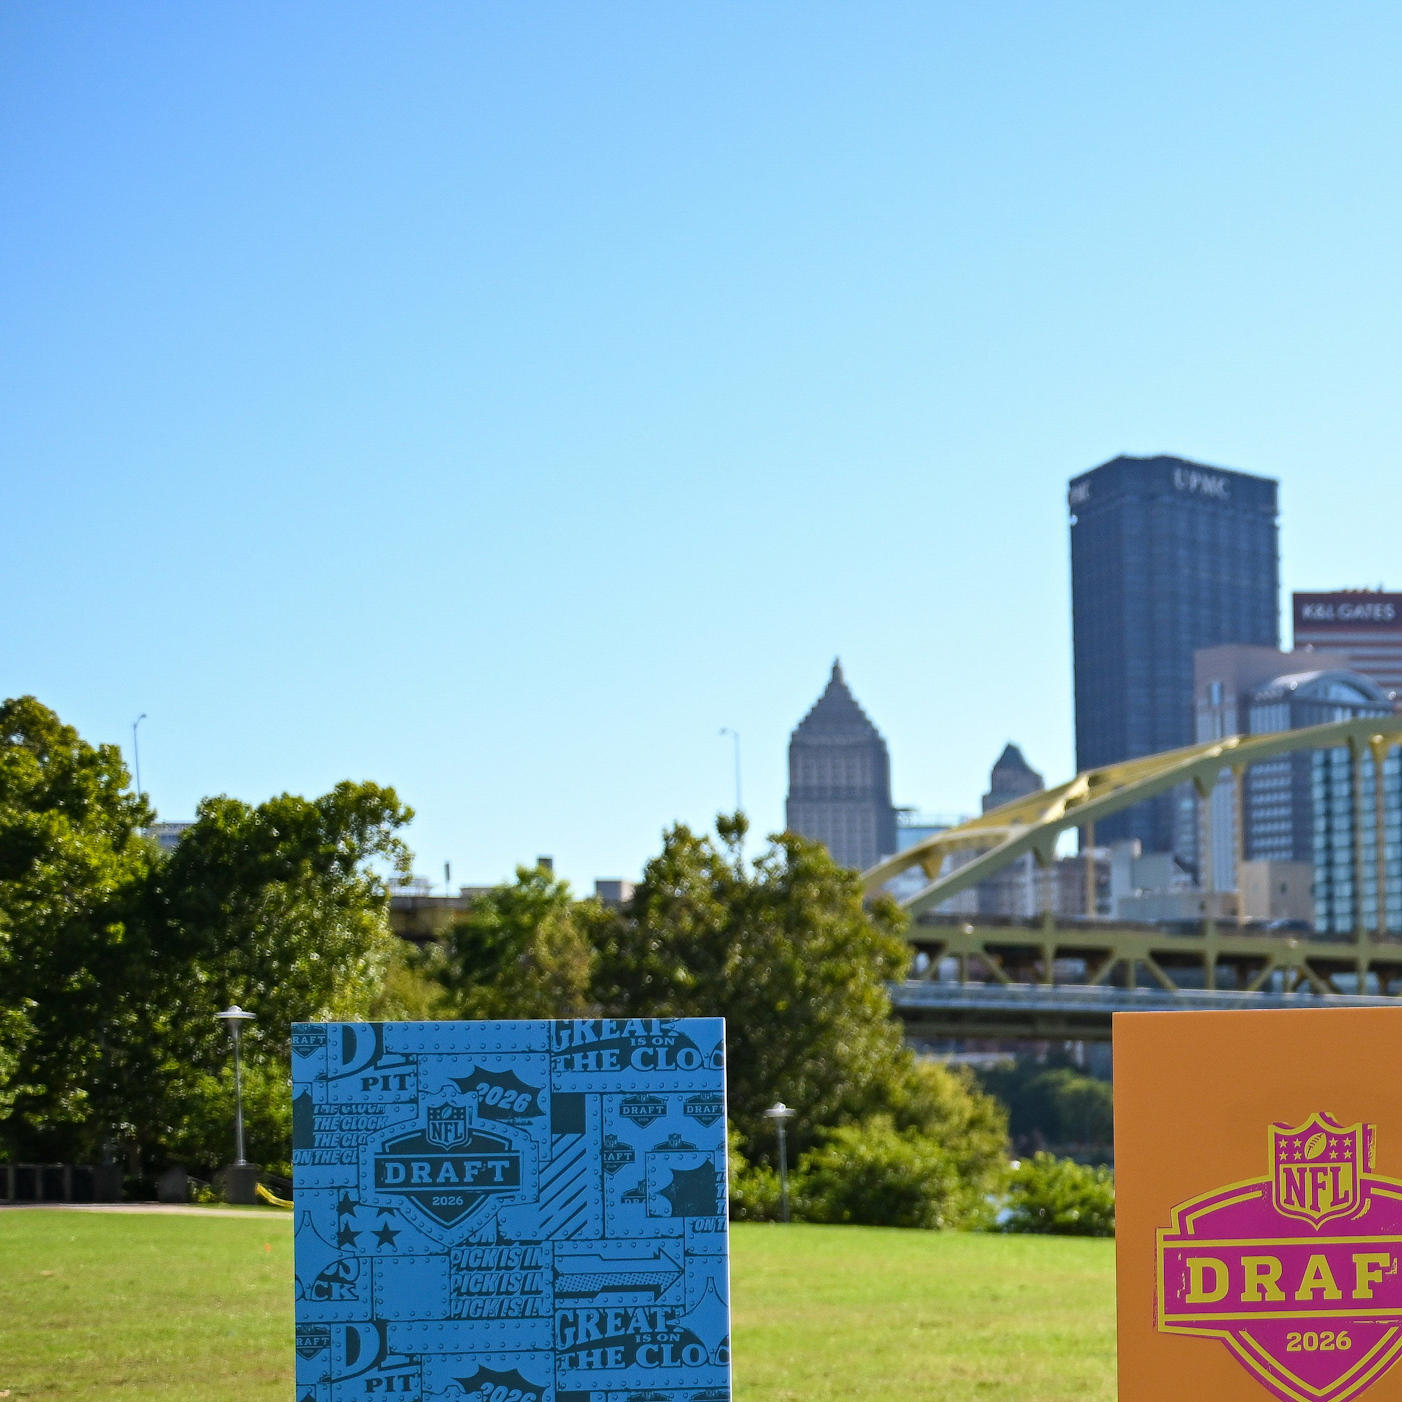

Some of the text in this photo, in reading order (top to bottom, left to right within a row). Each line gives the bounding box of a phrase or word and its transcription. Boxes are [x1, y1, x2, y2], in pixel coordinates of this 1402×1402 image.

[1337, 602, 1396, 620] GATES
[631, 1036, 675, 1047] IS ON
[552, 1049, 621, 1072] THE
[476, 1082, 533, 1113] 2026
[622, 1105, 664, 1115] DRAFT
[314, 1116, 339, 1132] THE
[431, 1121, 464, 1143] NFL
[314, 1132, 339, 1149] THE
[312, 1149, 339, 1165] THE
[384, 1160, 510, 1184] DRAFT
[1283, 1166, 1349, 1212] NFL
[432, 1195, 464, 1206] 2026
[451, 1246, 498, 1271] PICK
[451, 1271, 499, 1296] PICK
[635, 1333, 681, 1343] IS ON
[1286, 1331, 1352, 1352] 2026
[556, 1346, 626, 1370] THE
